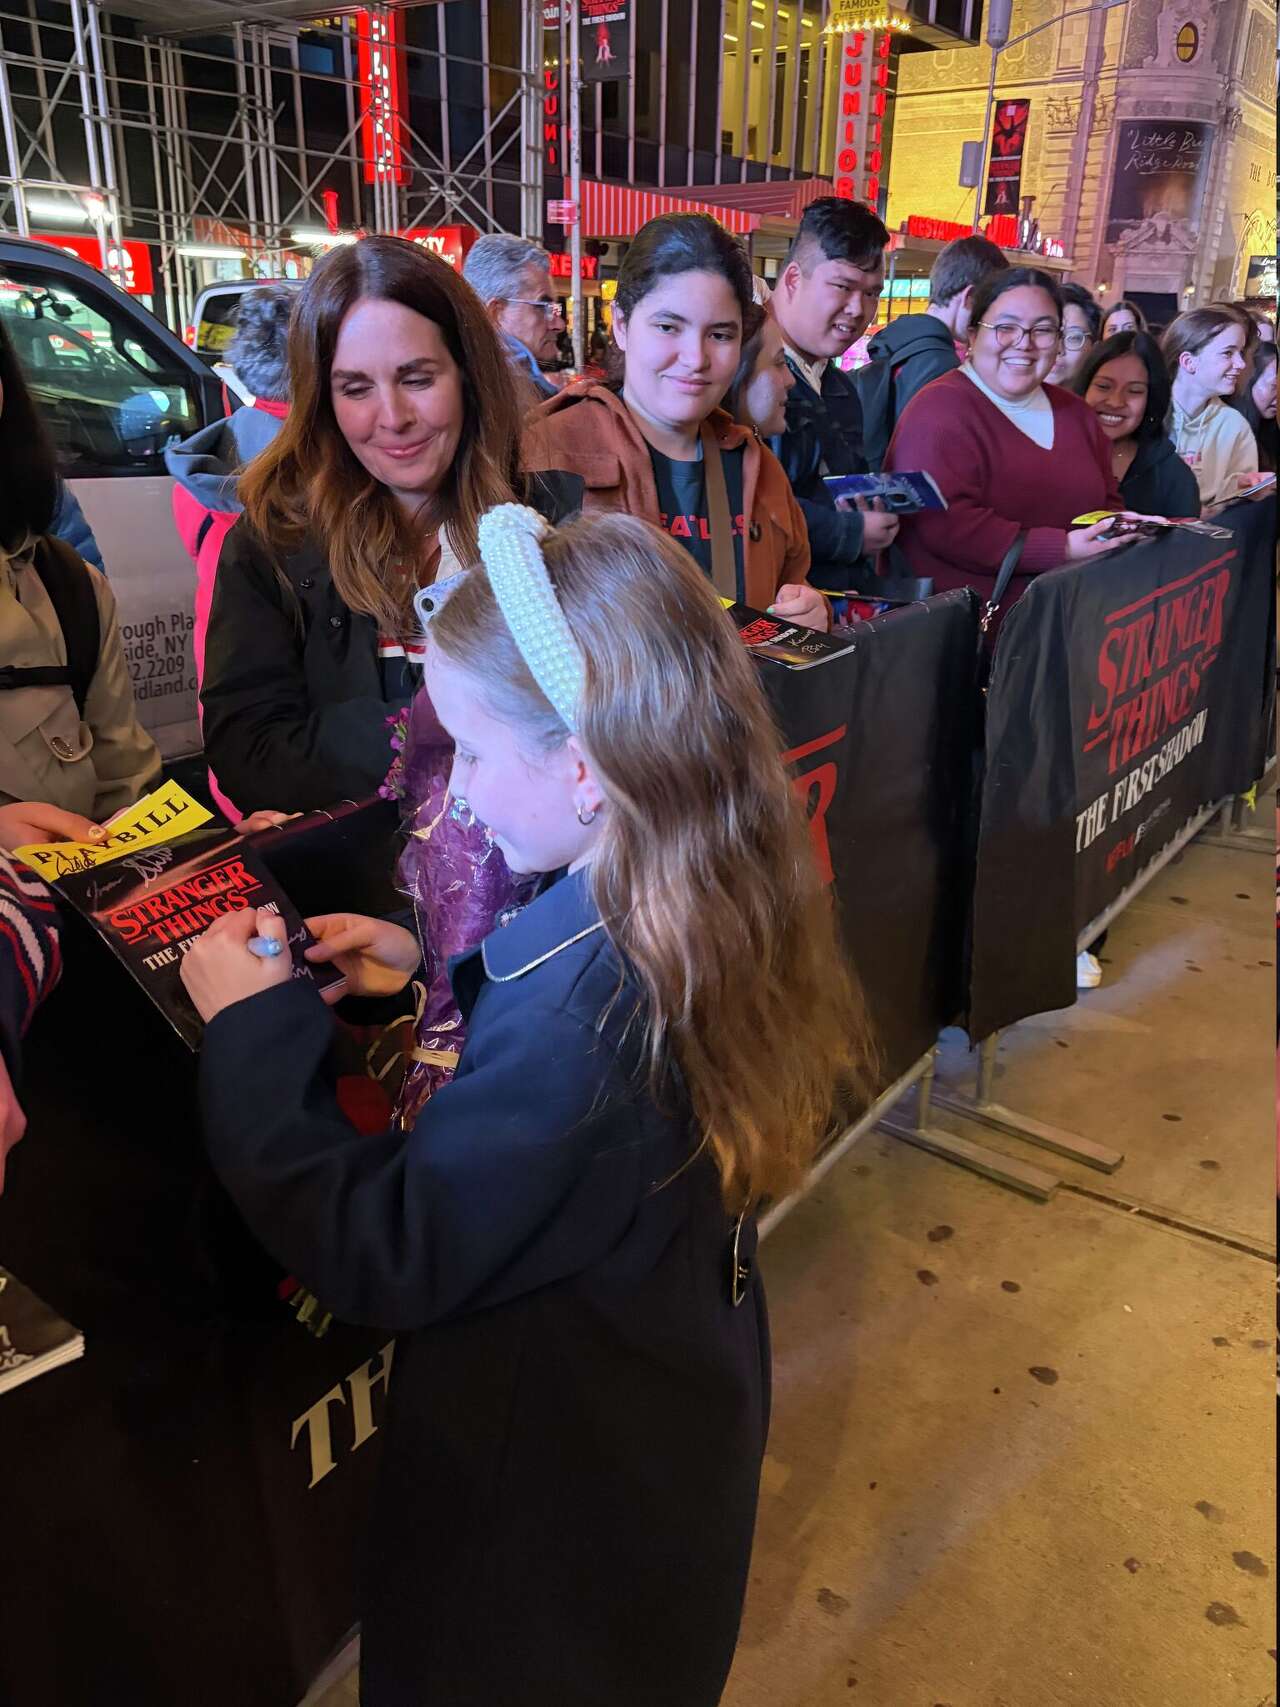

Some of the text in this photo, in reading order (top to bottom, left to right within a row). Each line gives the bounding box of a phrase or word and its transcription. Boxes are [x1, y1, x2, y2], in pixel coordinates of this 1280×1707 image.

[839, 0, 881, 11] FAMOUS
[119, 615, 167, 641] ough
[164, 633, 189, 655] NY
[1086, 568, 1231, 731] STRANGER
[127, 654, 185, 682] 2.2209
[1108, 652, 1203, 776] THINGS
[1075, 791, 1110, 854] THE
[1111, 753, 1159, 824] FIRST
[1154, 707, 1209, 784] SHADOW
[32, 797, 190, 865] PLAYBILL
[110, 861, 260, 940] STRANGER
[147, 888, 250, 945] THINGS
[142, 946, 180, 971] THE
